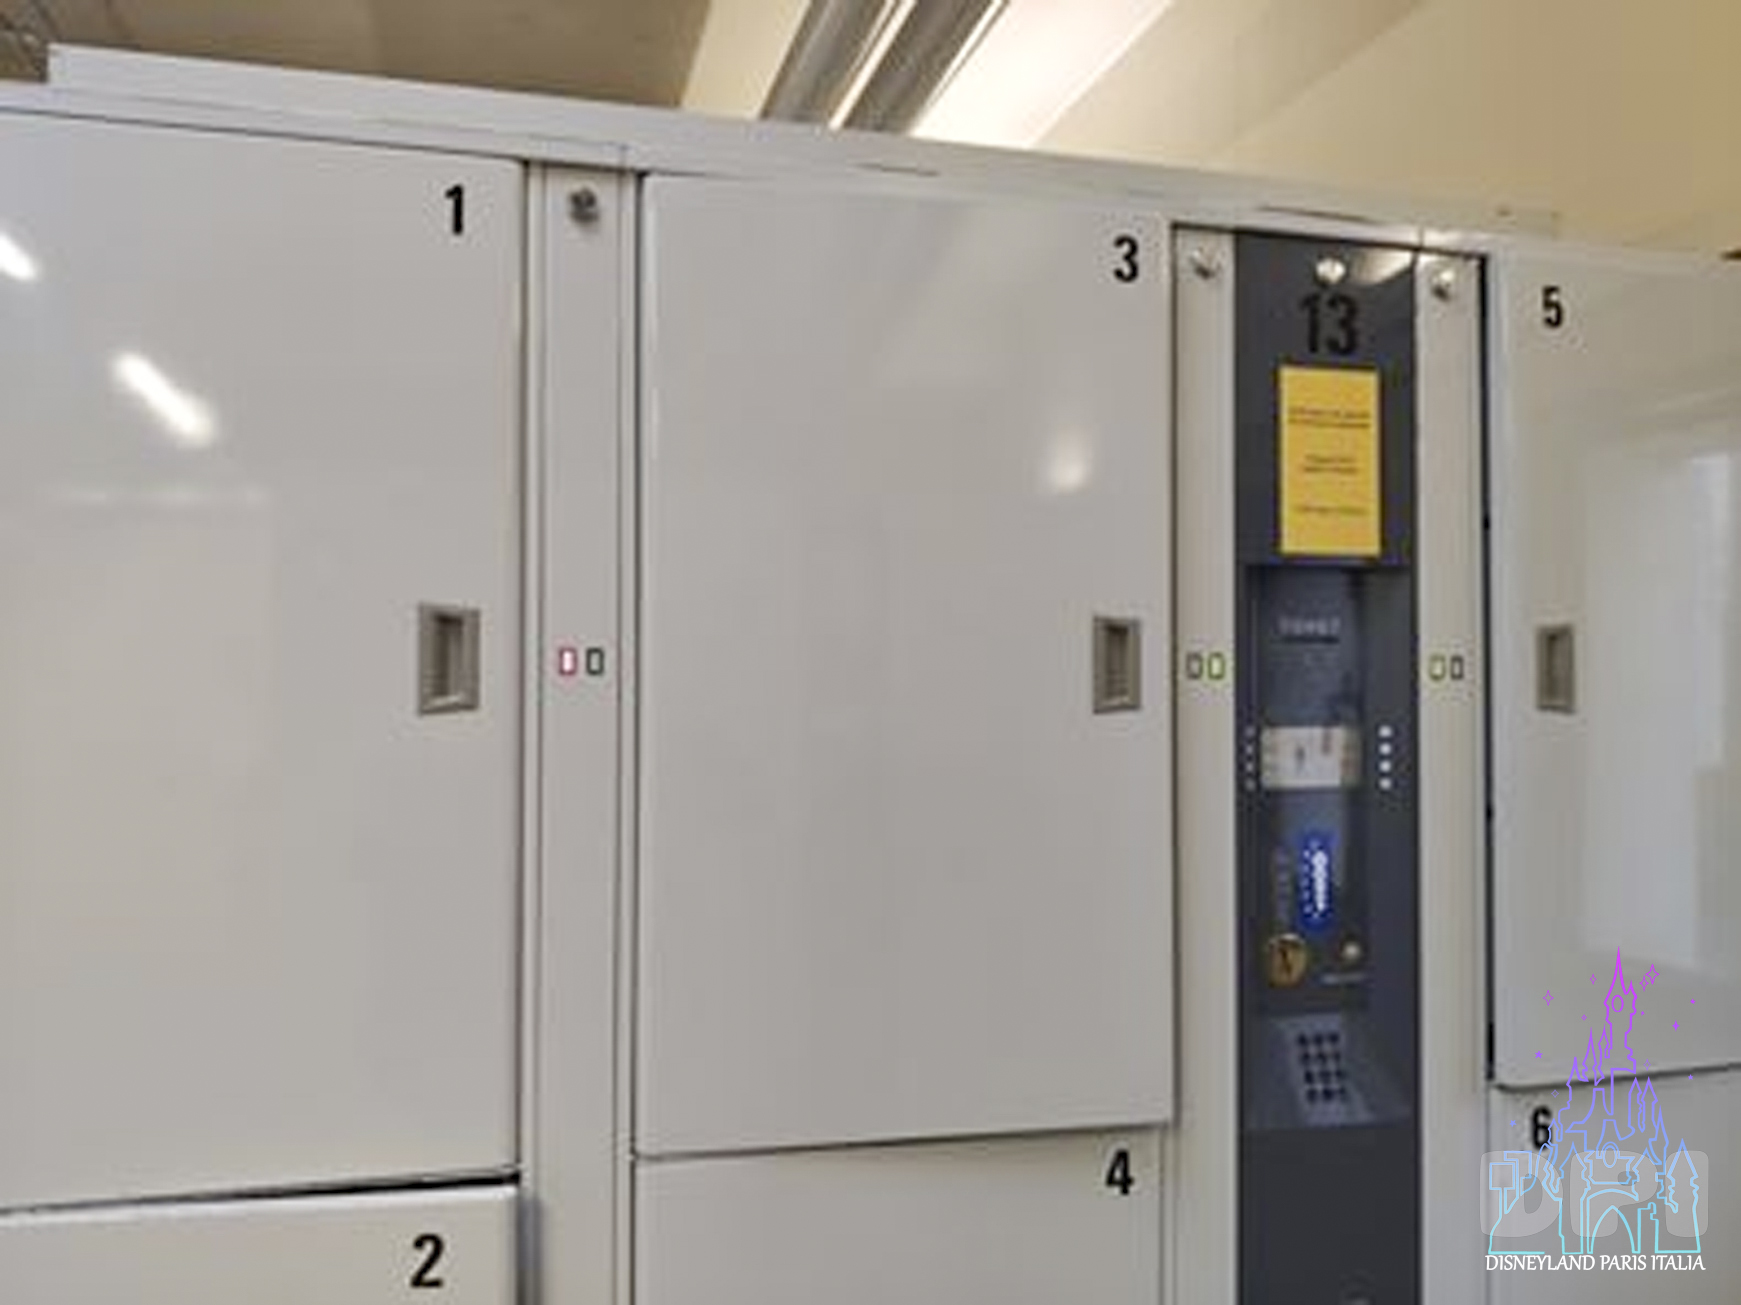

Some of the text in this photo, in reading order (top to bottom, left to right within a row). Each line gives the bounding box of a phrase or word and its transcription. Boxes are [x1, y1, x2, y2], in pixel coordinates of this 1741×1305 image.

[444, 184, 464, 235] 1
[1114, 235, 1139, 283] 3
[1300, 292, 1358, 355] 13
[1542, 286, 1564, 329] 5
[1530, 1105, 1553, 1151] 6
[1105, 1149, 1135, 1196] 4
[410, 1233, 444, 1288] 2
